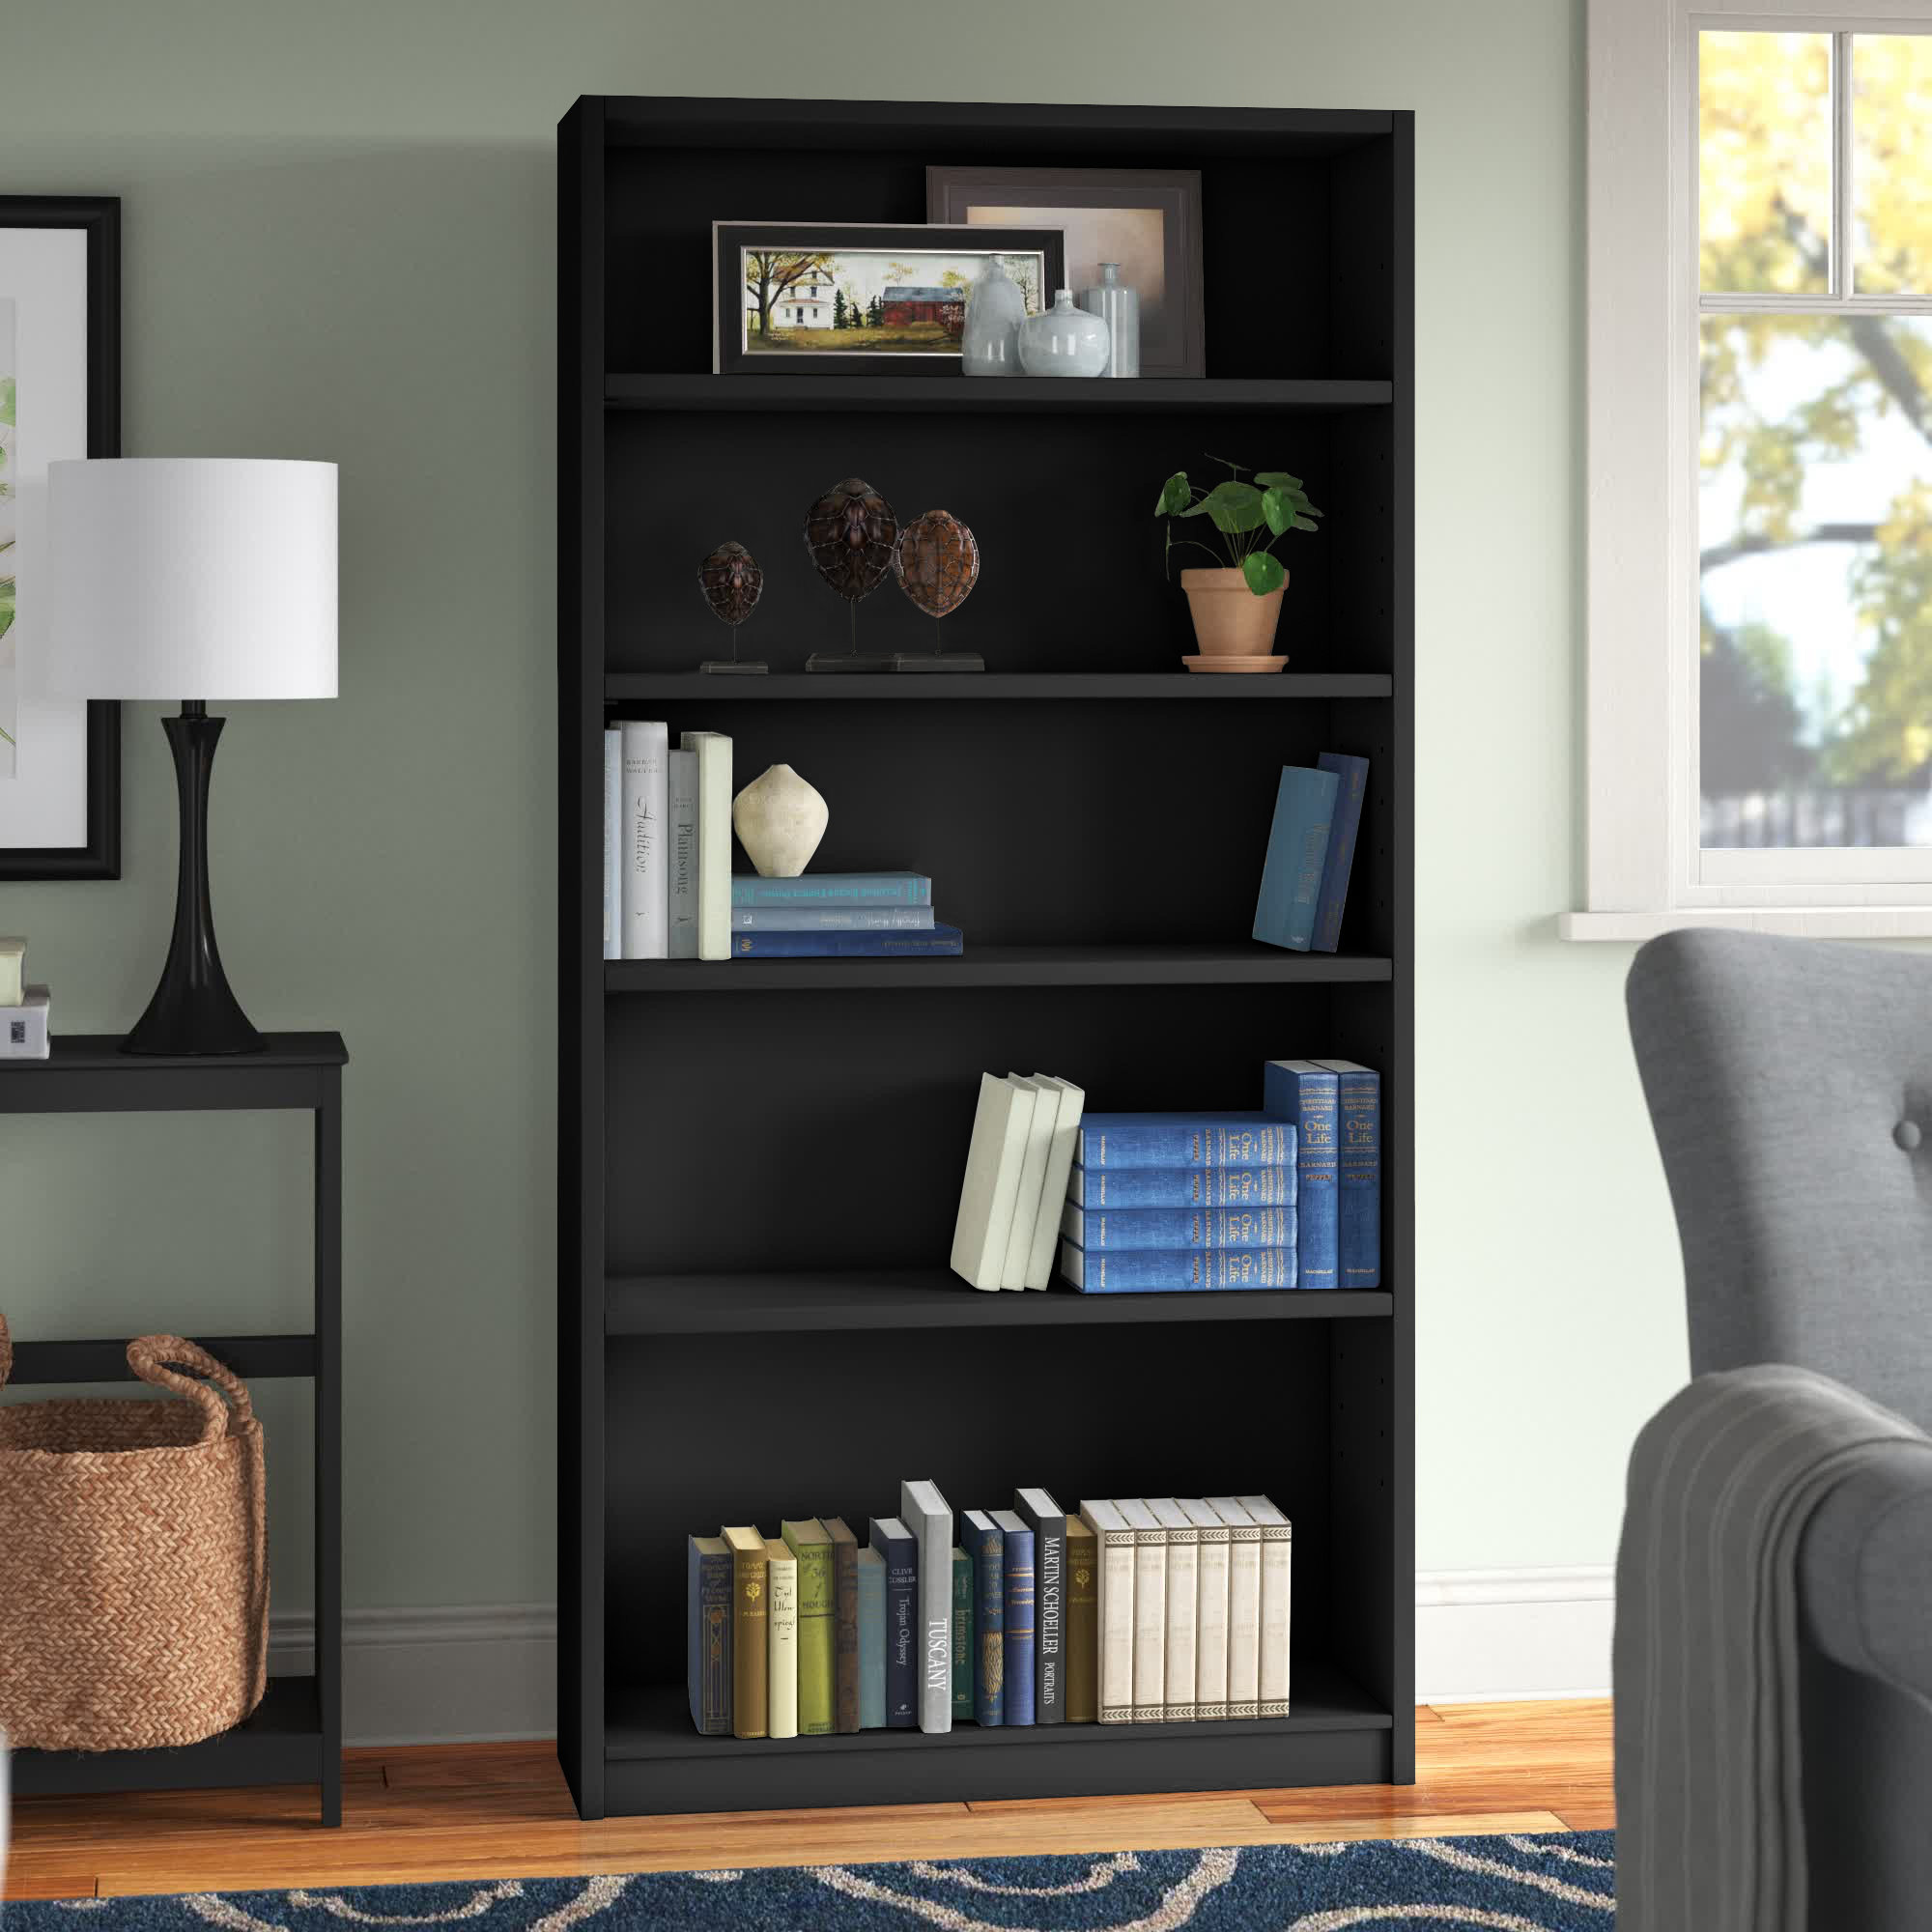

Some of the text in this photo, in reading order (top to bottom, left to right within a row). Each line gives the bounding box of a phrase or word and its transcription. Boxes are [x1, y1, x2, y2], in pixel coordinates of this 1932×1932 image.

[635, 795, 657, 873] Audition
[675, 823, 694, 895] Plainsong
[1304, 1121, 1331, 1131] One
[1307, 1133, 1332, 1145] Life
[1346, 1120, 1374, 1131] One
[1349, 1132, 1374, 1144] Life
[1229, 1135, 1241, 1160] Life
[1241, 1132, 1253, 1160] One
[1229, 1175, 1241, 1201] Life
[1241, 1172, 1253, 1201] One
[1229, 1216, 1241, 1242] Life
[1241, 1213, 1253, 1242] One
[1229, 1256, 1241, 1283] Life
[1241, 1254, 1253, 1283] One
[896, 1595, 910, 1665] Trojan Odyssey
[1042, 1537, 1061, 1705] MARTIN SCHOELLER PORTRAITS
[927, 1618, 948, 1691] TUSCANY
